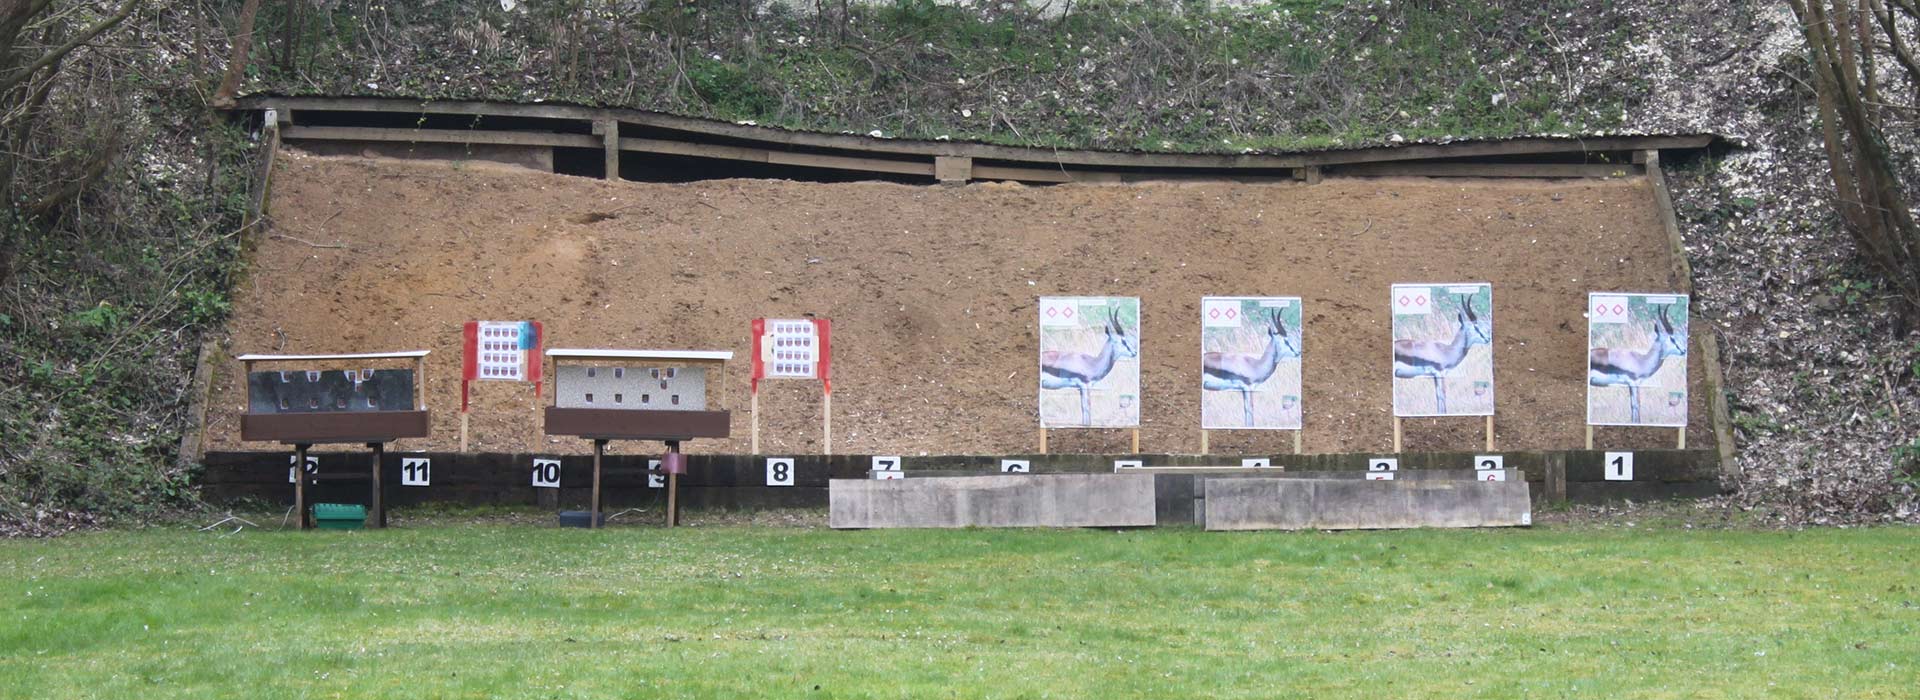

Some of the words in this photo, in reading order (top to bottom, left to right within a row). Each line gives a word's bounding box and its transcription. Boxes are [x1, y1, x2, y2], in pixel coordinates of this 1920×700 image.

[404, 461, 428, 481] 11
[533, 463, 560, 482] 10
[773, 462, 788, 482] 8
[1612, 456, 1623, 476] 1
